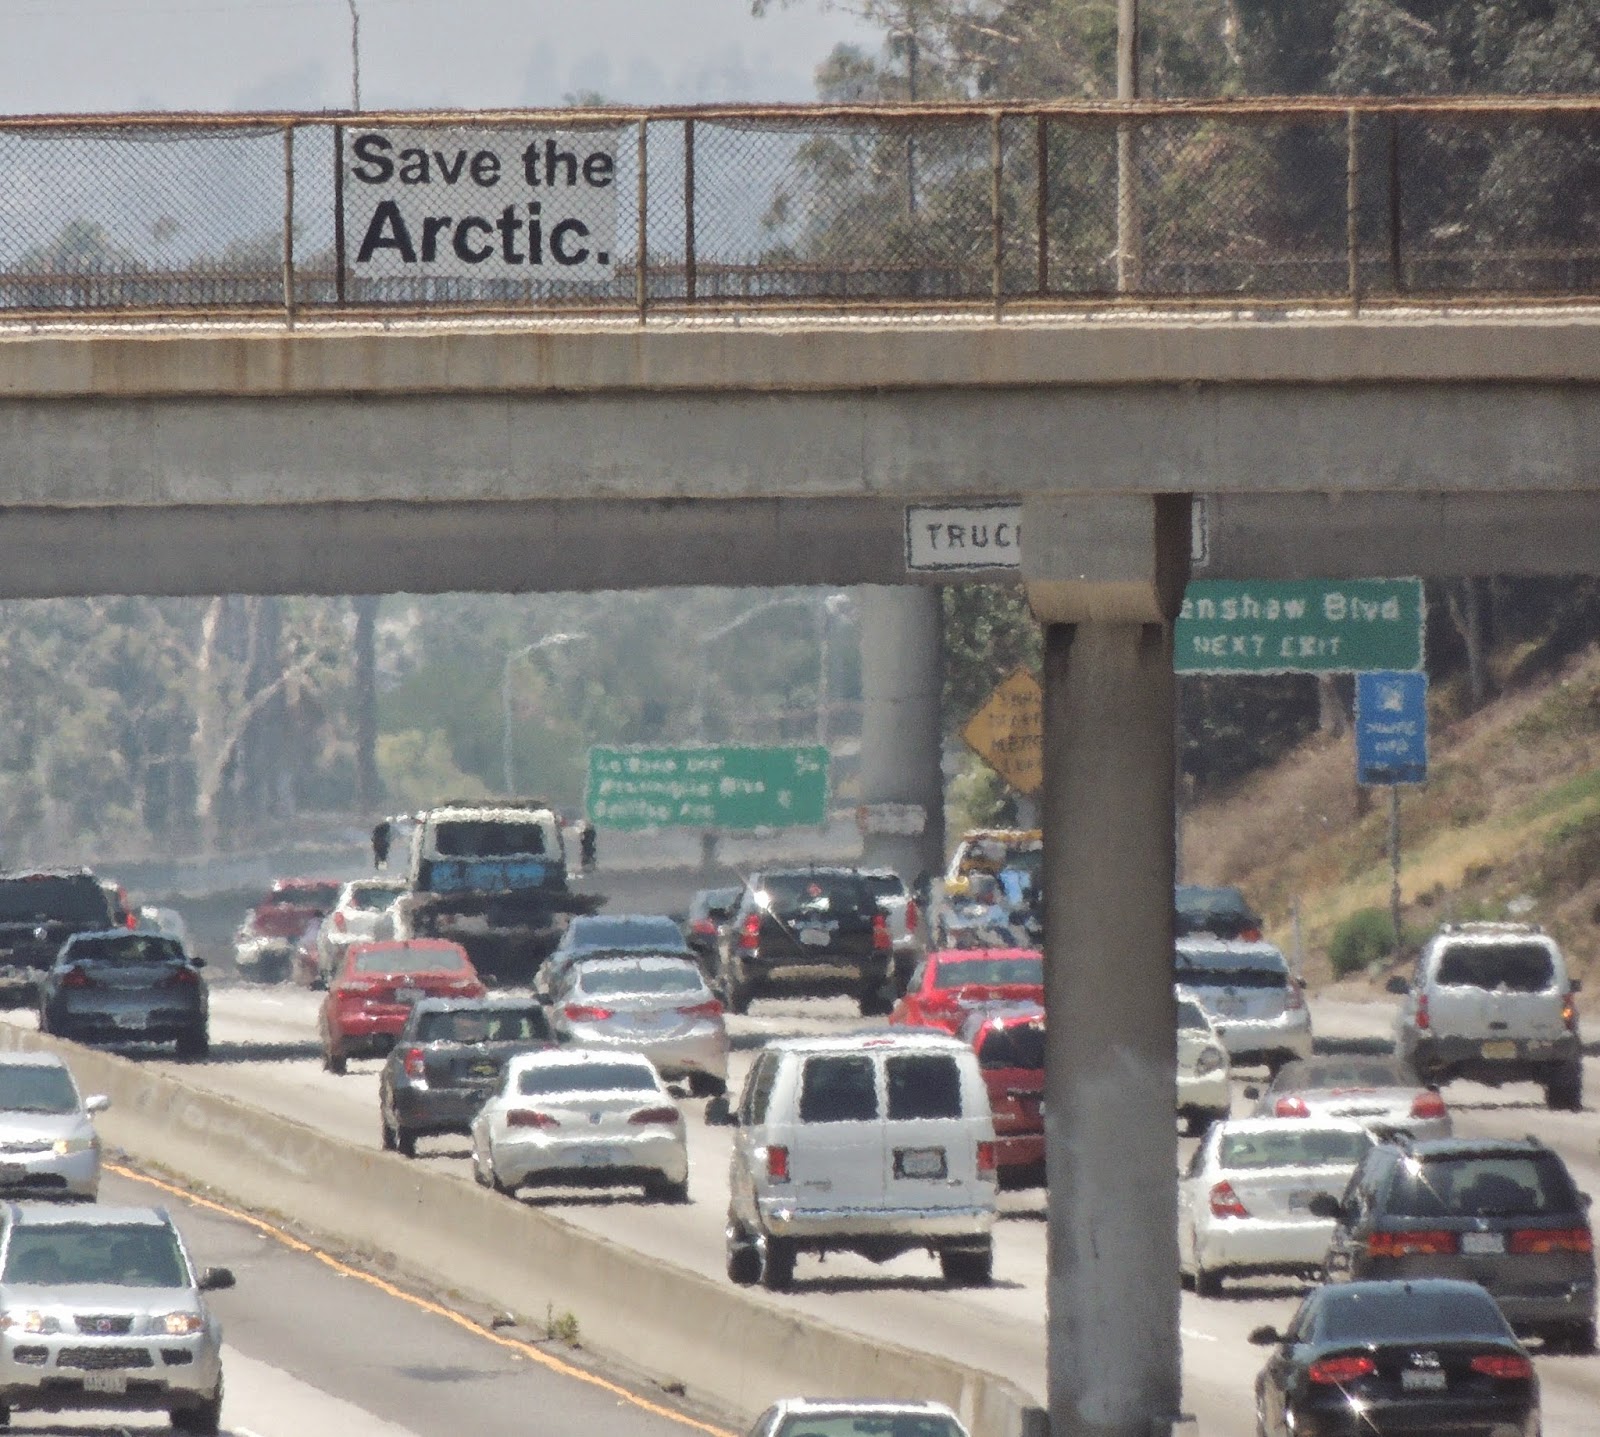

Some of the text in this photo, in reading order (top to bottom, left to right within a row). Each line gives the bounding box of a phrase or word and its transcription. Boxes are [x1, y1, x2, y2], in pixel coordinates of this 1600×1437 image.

[351, 134, 614, 188] Save the
[356, 200, 609, 265] Arctic.
[926, 522, 1021, 548] TRUC
[1323, 593, 1400, 622] Blvd
[1193, 634, 1341, 658] NEXT EXIT
